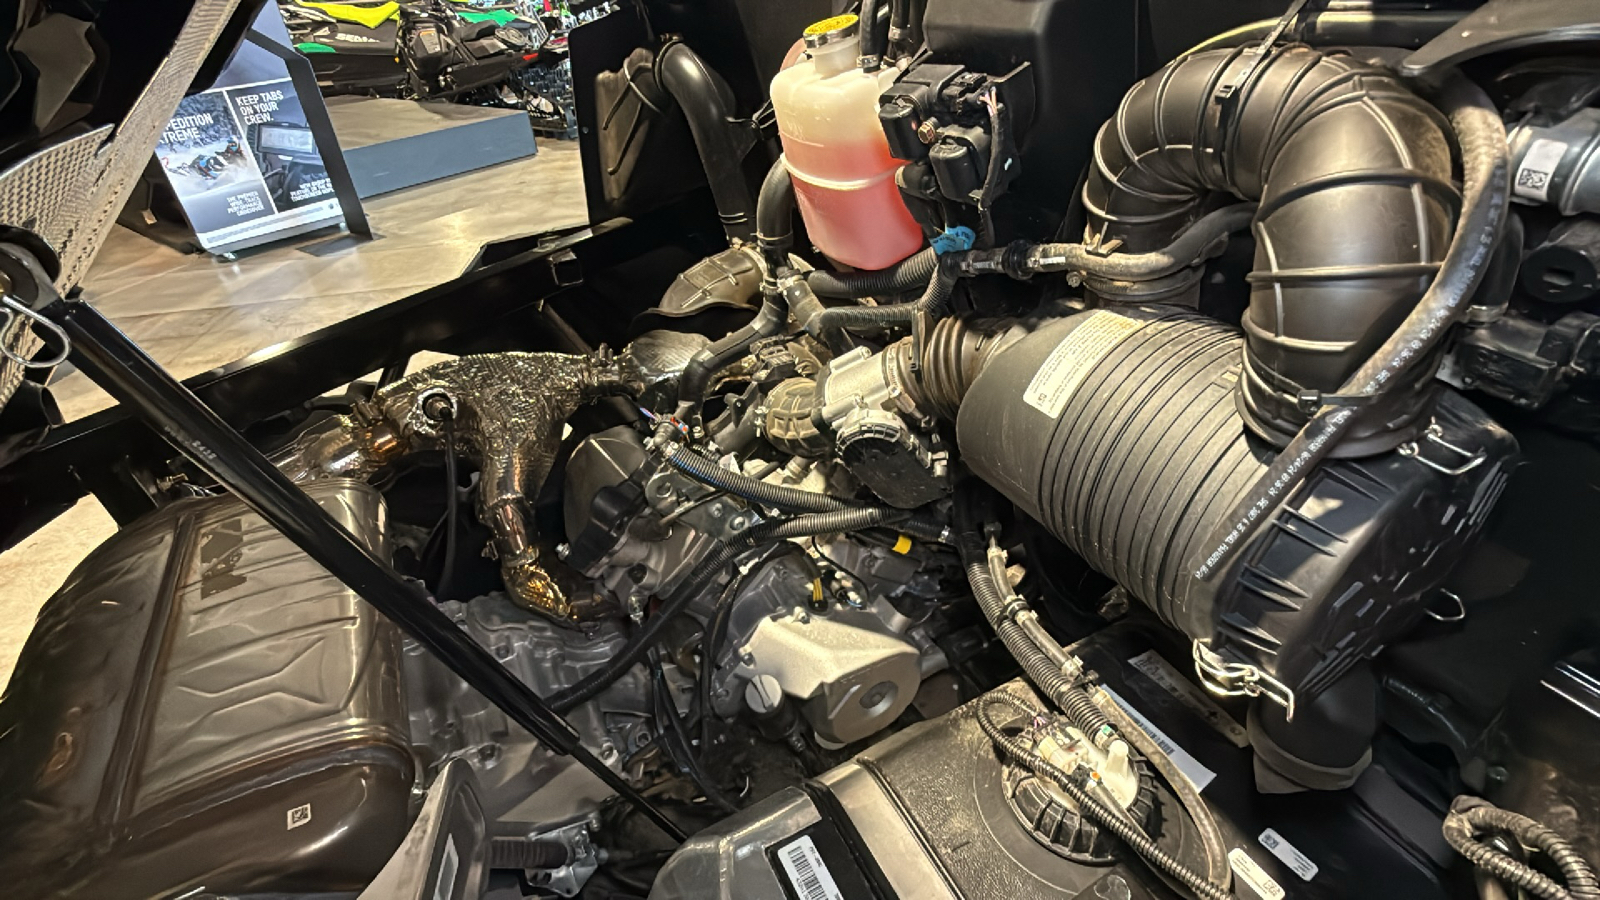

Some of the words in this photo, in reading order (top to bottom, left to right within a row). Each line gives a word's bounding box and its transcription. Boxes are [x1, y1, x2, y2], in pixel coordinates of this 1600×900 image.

[236, 94, 259, 106] KEEP
[259, 90, 284, 102] TABS
[240, 105, 254, 116] ON
[253, 101, 279, 113] YOUR
[244, 112, 274, 125] CREW.
